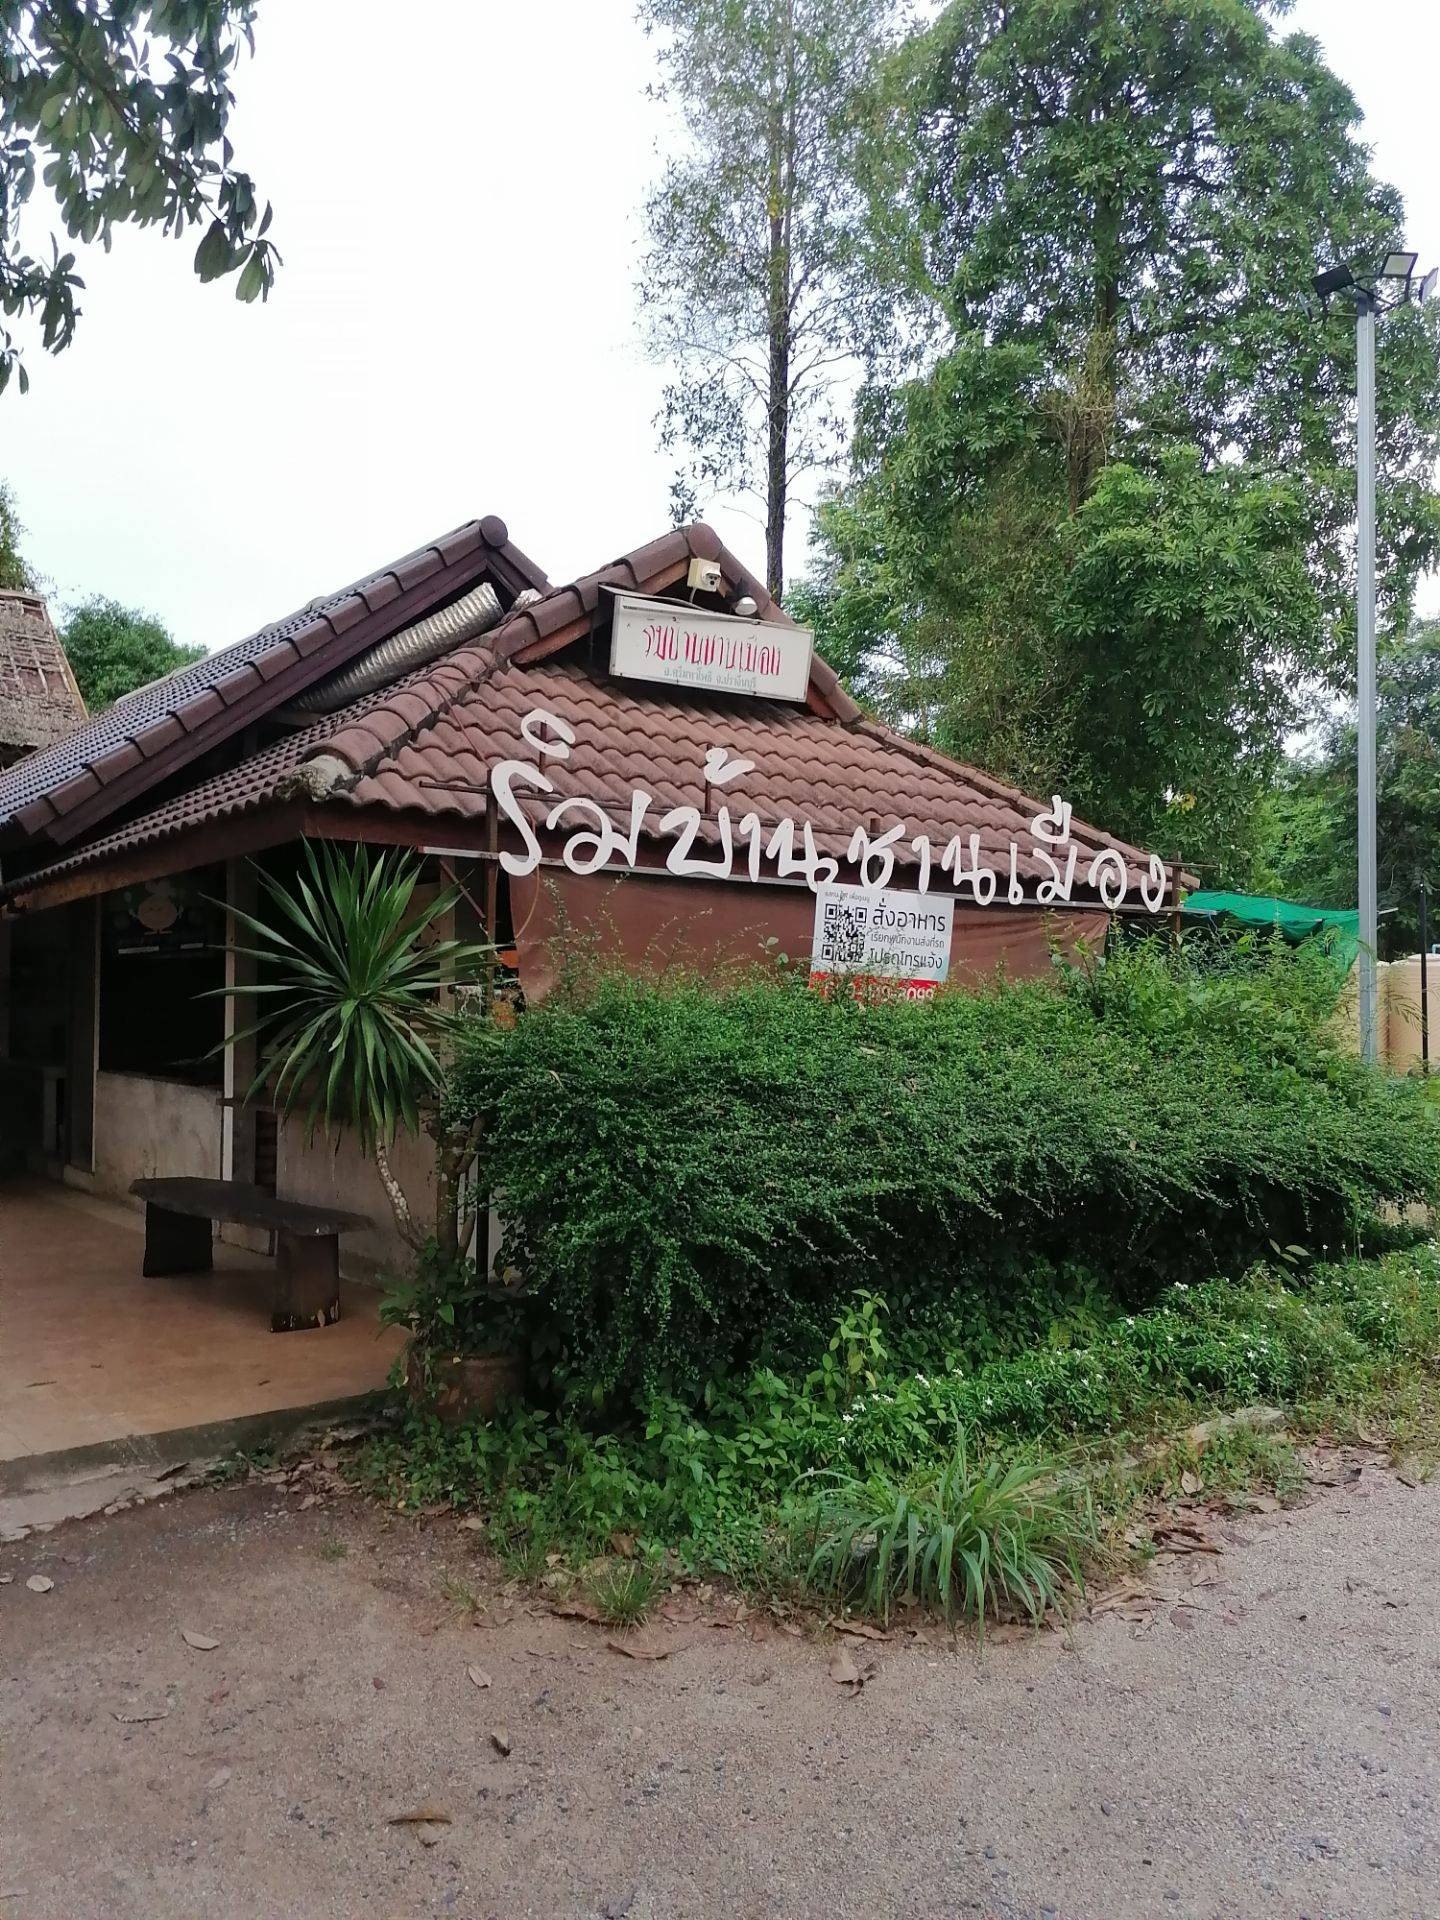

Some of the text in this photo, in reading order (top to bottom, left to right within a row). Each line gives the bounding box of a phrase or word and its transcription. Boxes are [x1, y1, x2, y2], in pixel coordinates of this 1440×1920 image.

[490, 709, 1166, 912] ริมบ้านชานเมือง
[873, 898, 946, 932] สั่งอาหาร
